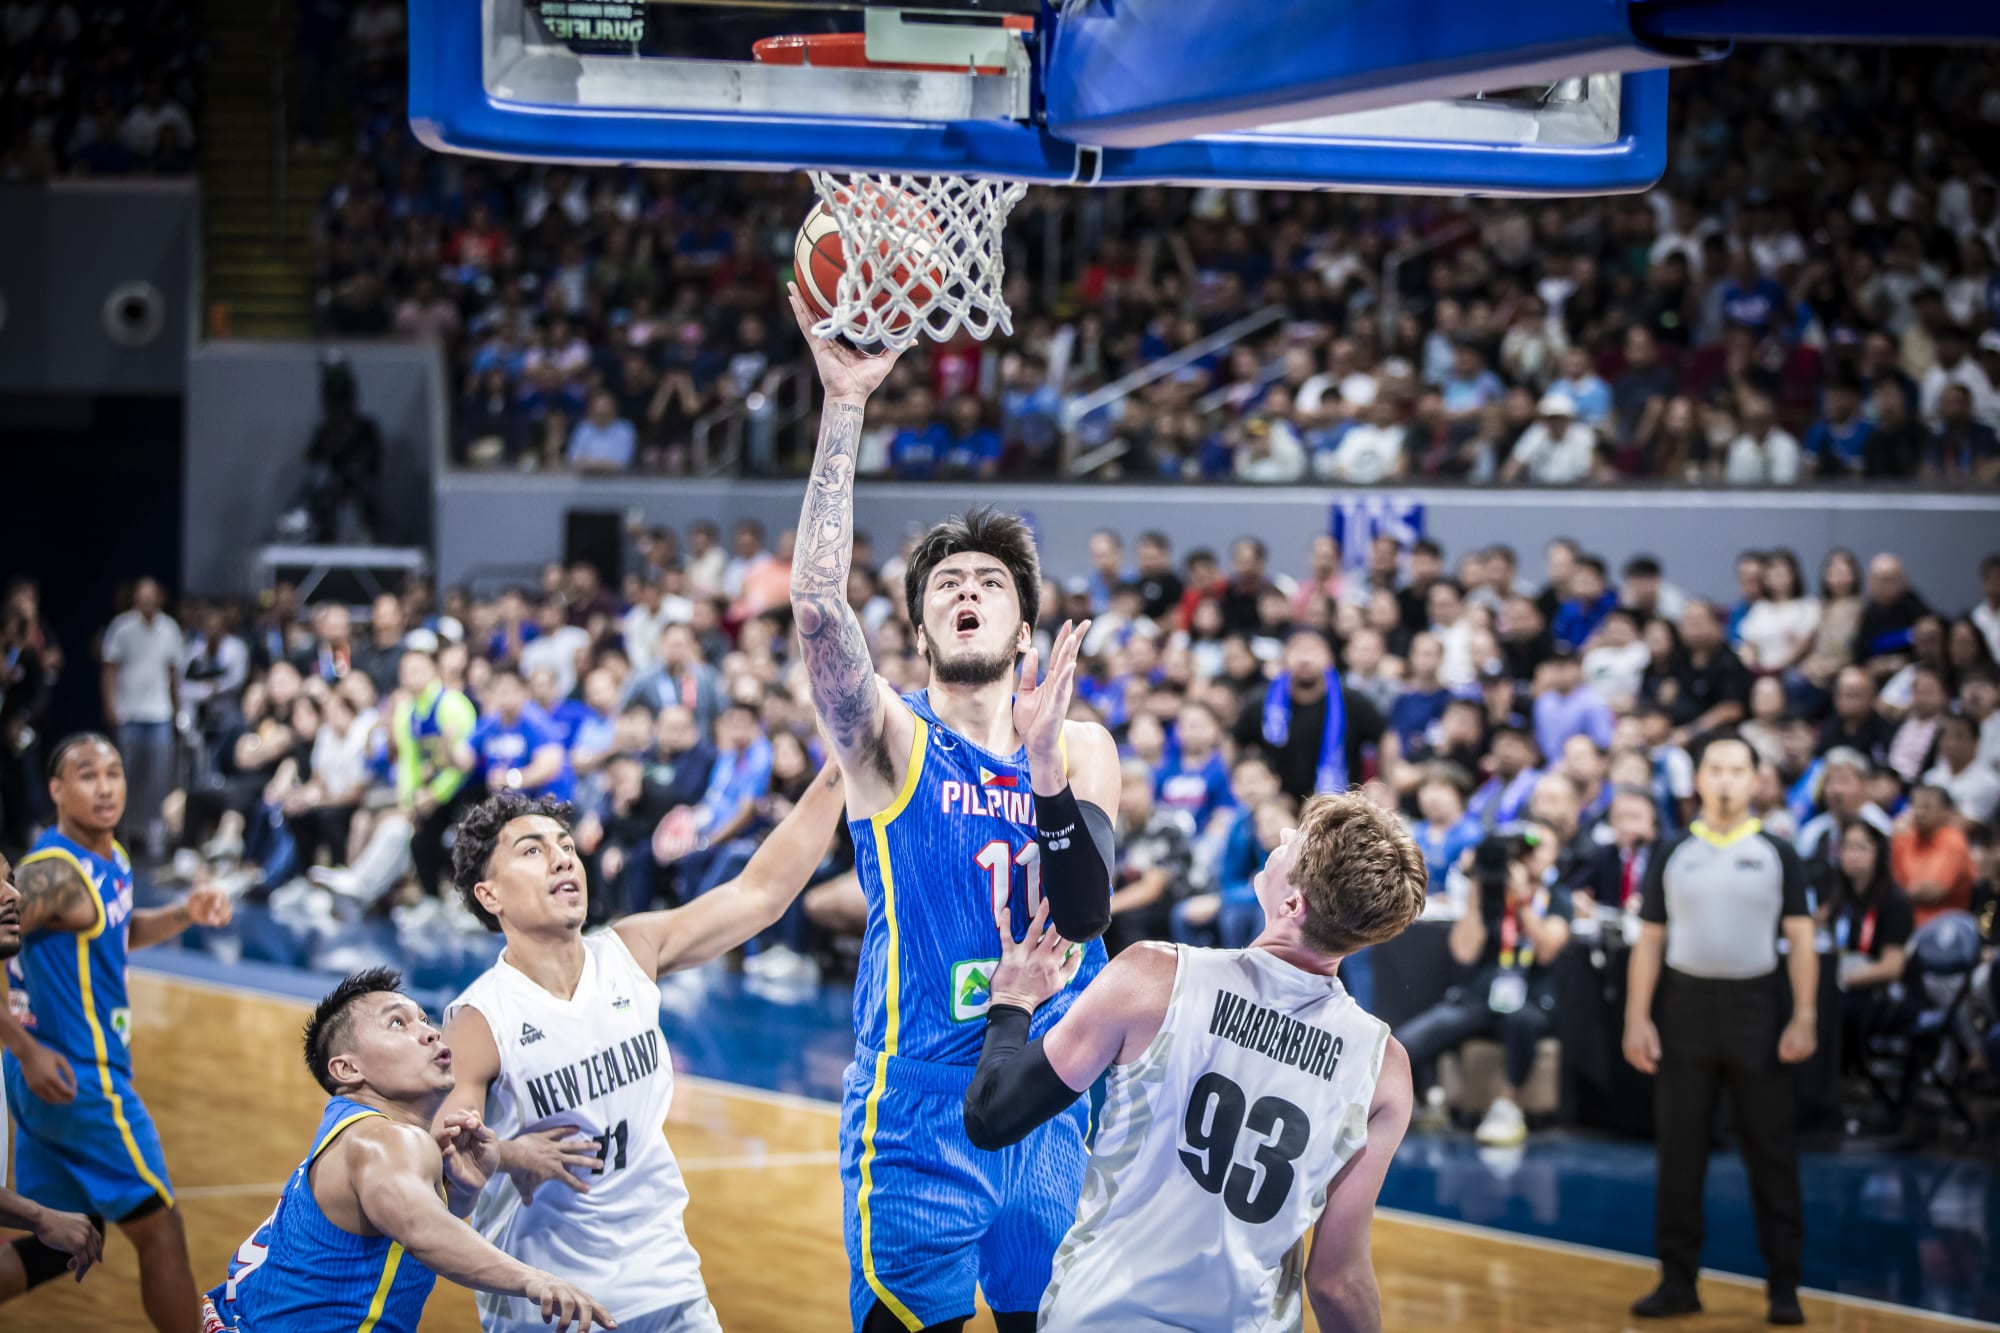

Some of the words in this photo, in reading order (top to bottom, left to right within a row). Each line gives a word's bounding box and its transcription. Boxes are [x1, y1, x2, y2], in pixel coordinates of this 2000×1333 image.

[942, 780, 1037, 826] PILPIN
[974, 840, 1043, 930] 11
[520, 1030, 545, 1046] PEAK
[526, 1064, 583, 1120] NEW
[580, 1029, 658, 1101] ZEALAND
[1208, 989, 1344, 1082] WAARDENBURG
[1178, 1072, 1310, 1224] 93
